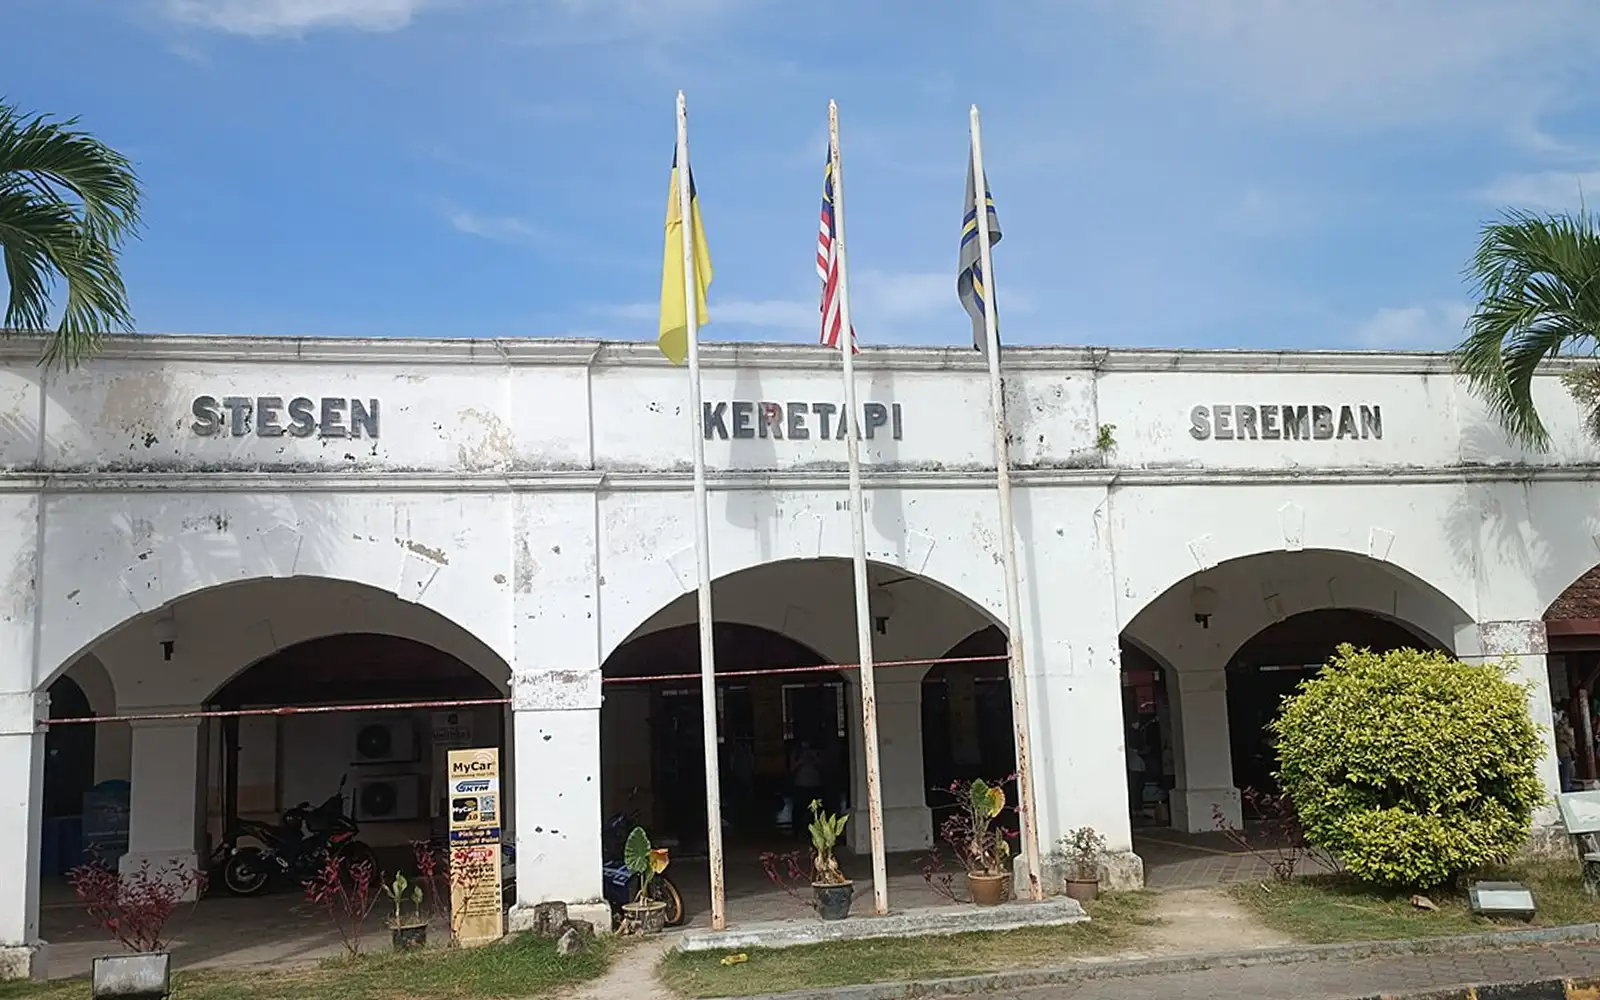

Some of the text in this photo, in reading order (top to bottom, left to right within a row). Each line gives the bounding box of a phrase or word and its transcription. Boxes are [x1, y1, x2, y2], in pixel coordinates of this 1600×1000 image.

[191, 395, 380, 438] STESEN
[703, 401, 904, 440] KERETAPI
[1189, 404, 1384, 440] SEREMBAN
[453, 761, 492, 773] MyCar
